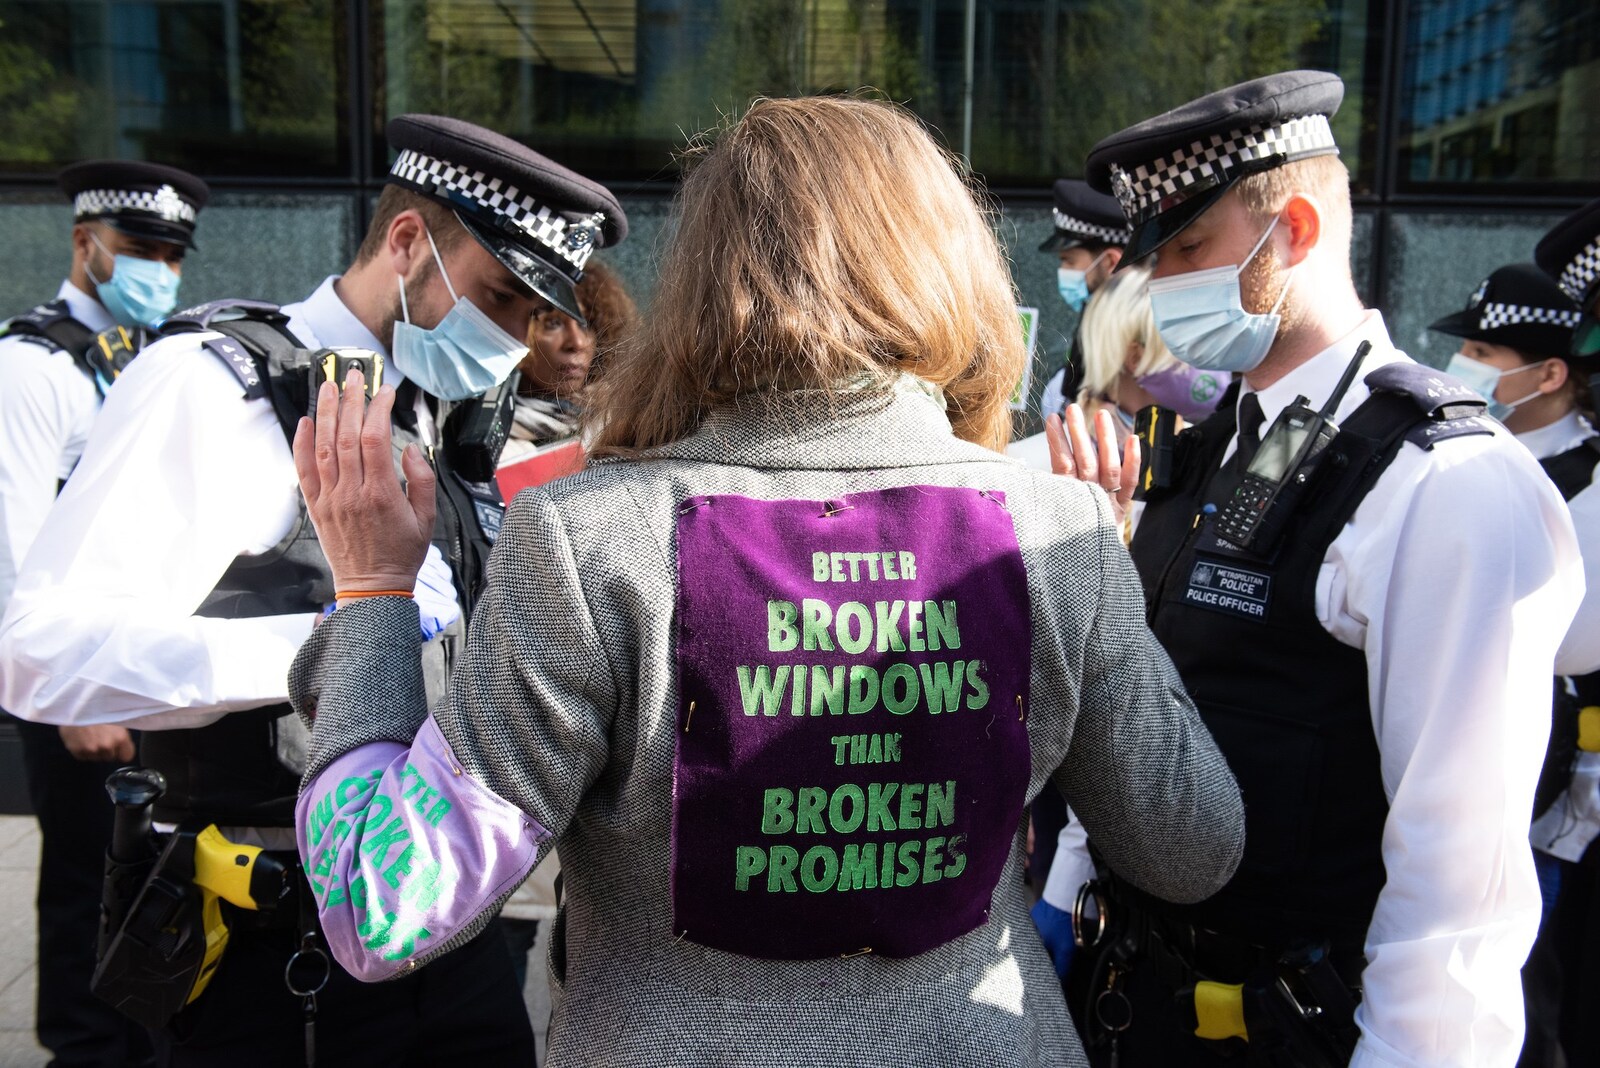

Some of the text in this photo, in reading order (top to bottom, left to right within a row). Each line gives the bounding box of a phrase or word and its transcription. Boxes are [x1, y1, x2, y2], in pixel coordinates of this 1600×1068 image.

[812, 551, 916, 582] BETTER
[1217, 569, 1263, 585] METROPOLITAN
[1187, 589, 1265, 616] POLICE OFFICER
[1220, 578, 1255, 594] POLICE
[768, 599, 961, 654] BROKEN
[736, 659, 991, 717] WINDOWS
[831, 733, 903, 766] THAN
[761, 780, 957, 835] BROKEN
[735, 832, 968, 893] PROMISES
